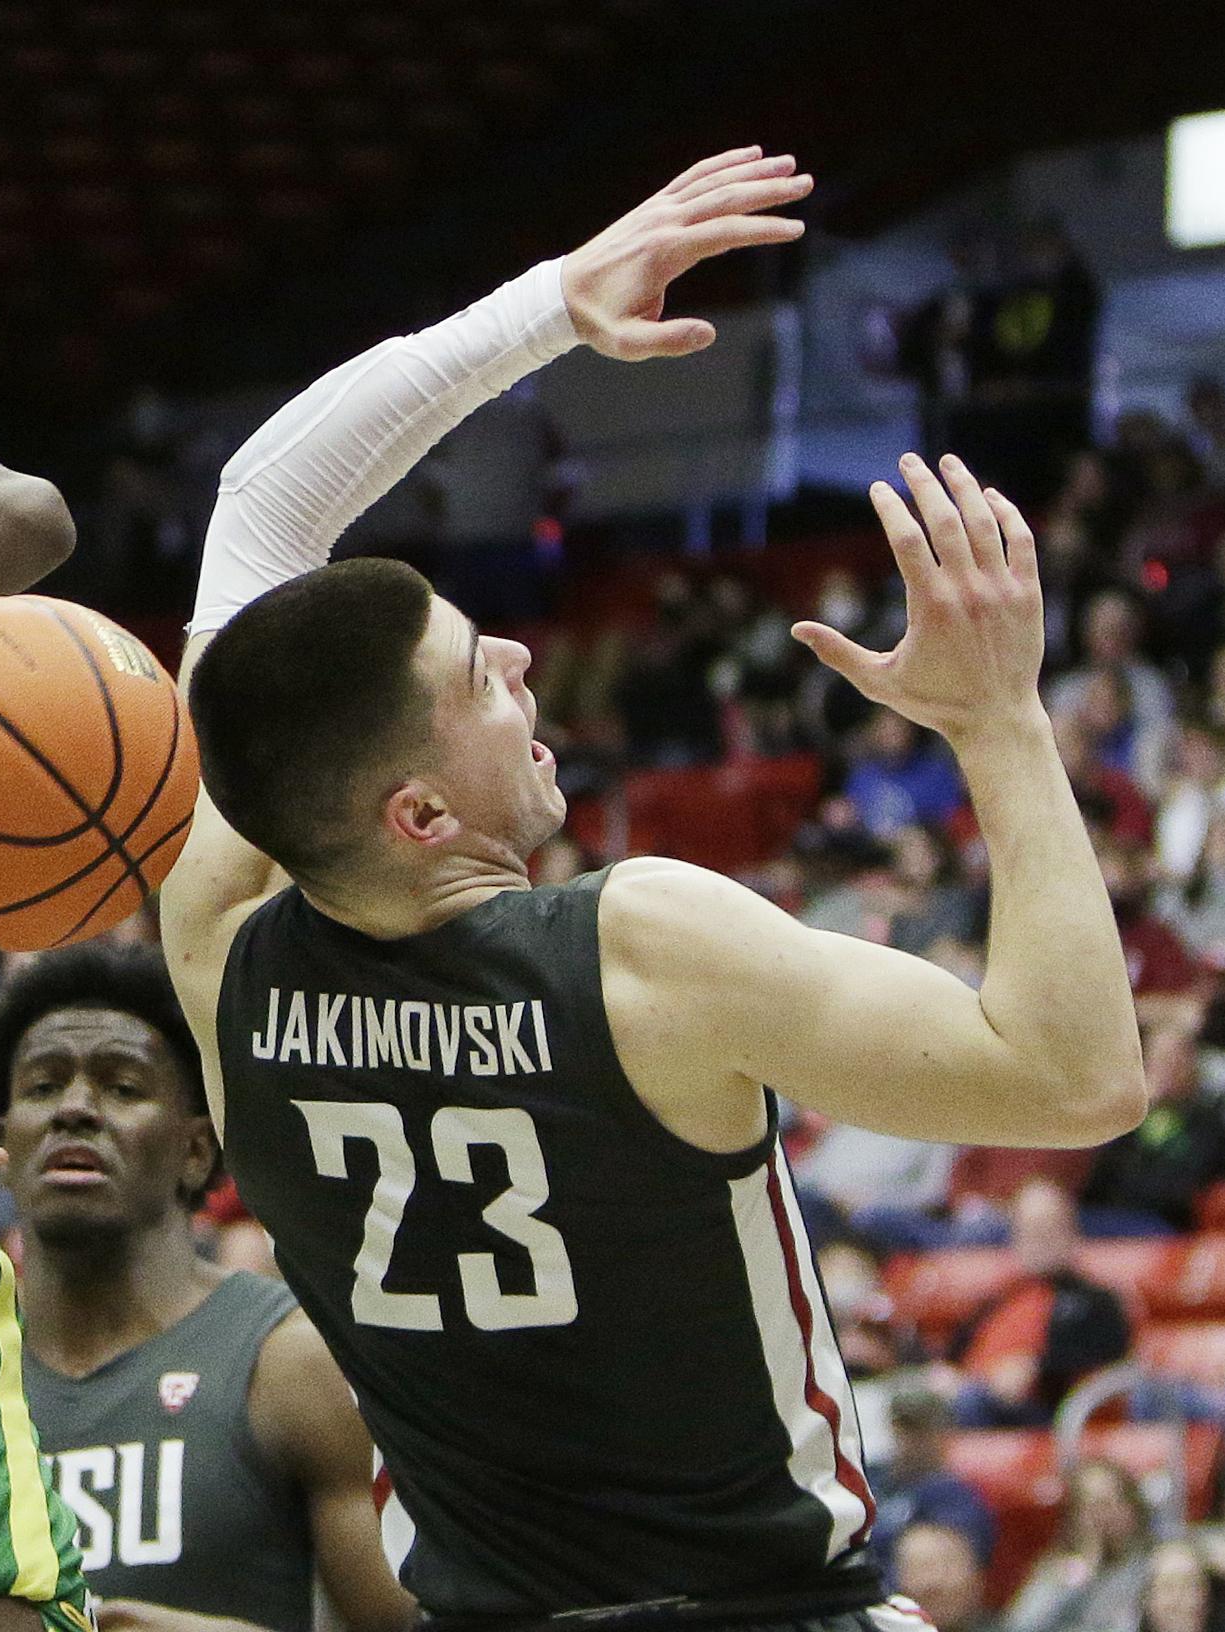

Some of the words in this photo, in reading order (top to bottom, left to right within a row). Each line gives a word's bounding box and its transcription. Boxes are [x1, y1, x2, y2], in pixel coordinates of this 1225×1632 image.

[251, 986, 554, 1077] JAKIMOVSKI
[289, 1098, 580, 1332] 23
[40, 1438, 185, 1572] SU
